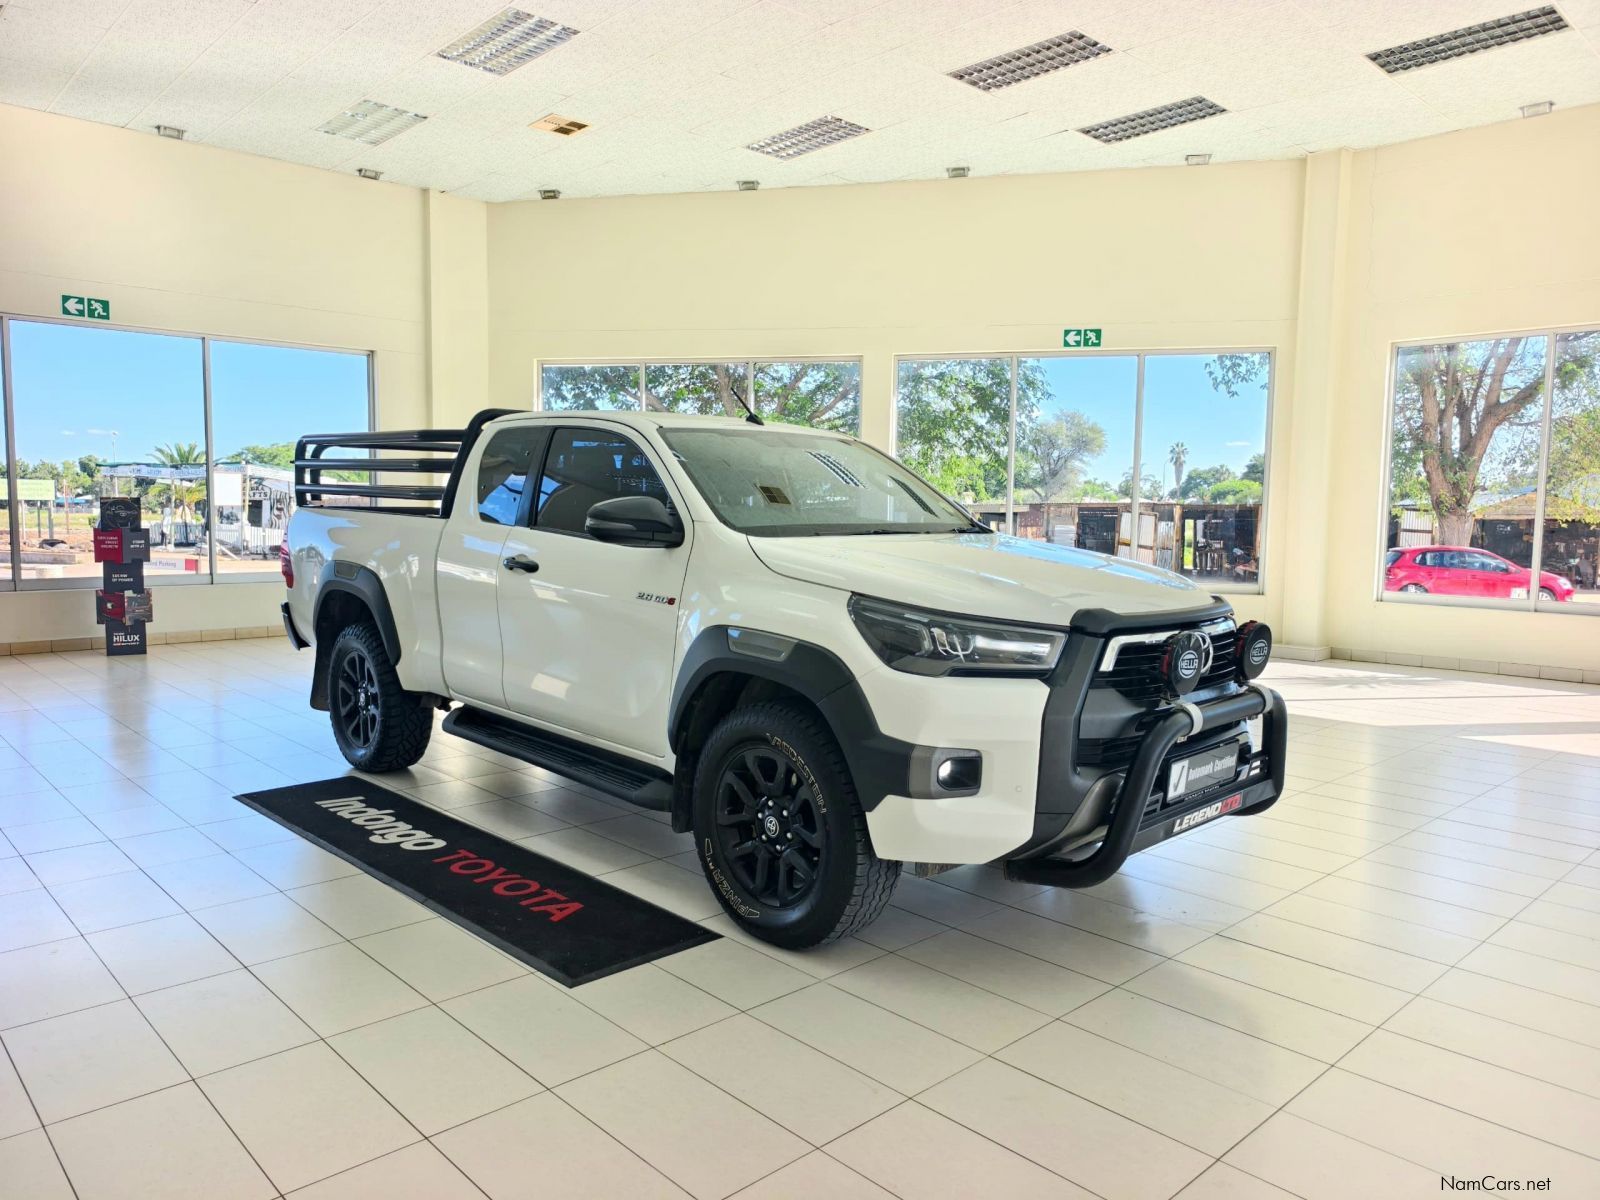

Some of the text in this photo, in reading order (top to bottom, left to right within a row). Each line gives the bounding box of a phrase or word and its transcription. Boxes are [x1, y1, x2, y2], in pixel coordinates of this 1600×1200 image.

[113, 634, 140, 643] HILUX
[1251, 646, 1268, 657] HELLA
[1180, 658, 1199, 670] HELLA
[1173, 801, 1222, 833] LEGEND
[314, 796, 584, 923] Indongo TOYOTA
[712, 868, 749, 917] PINZA
